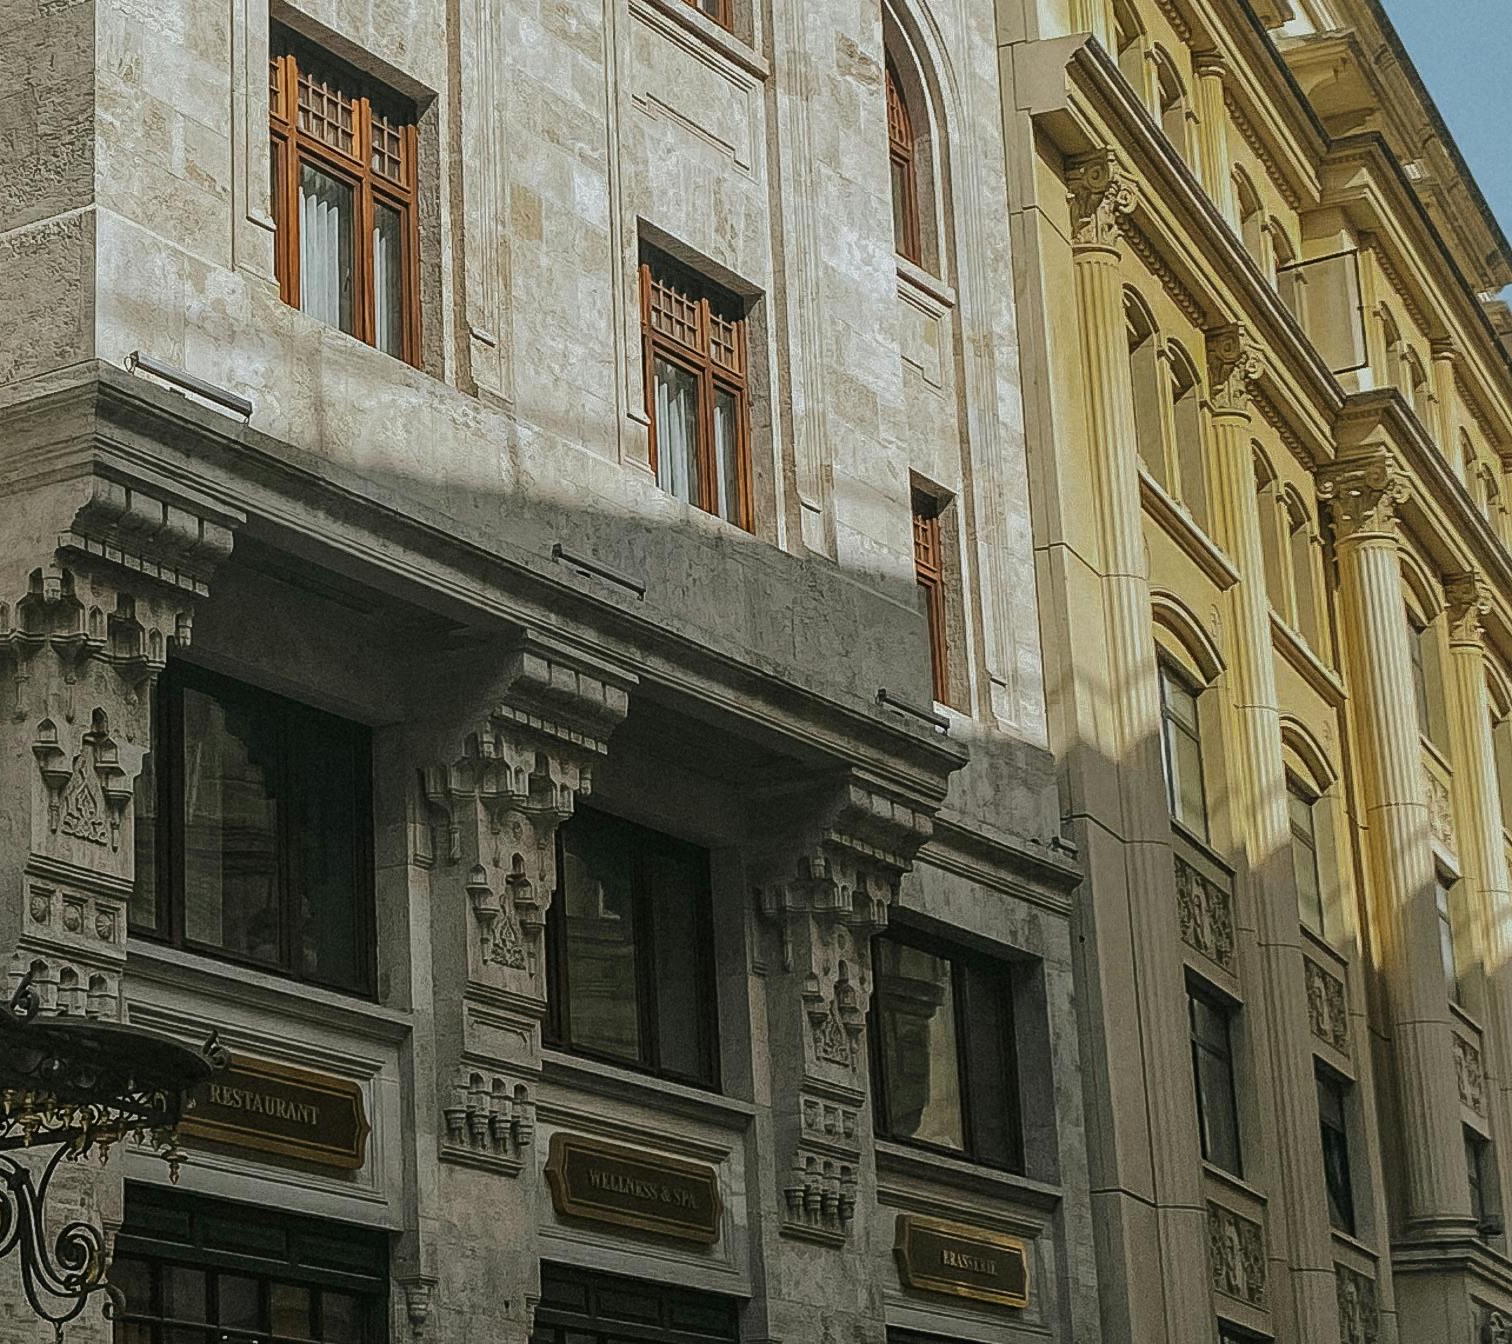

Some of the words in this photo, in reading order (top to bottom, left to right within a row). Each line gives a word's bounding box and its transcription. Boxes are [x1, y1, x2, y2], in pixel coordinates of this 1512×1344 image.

[208, 1083, 319, 1126] RESTAURANT
[589, 1168, 658, 1201] WELLNESS
[660, 1185, 672, 1203] &
[673, 1188, 697, 1210] SPA
